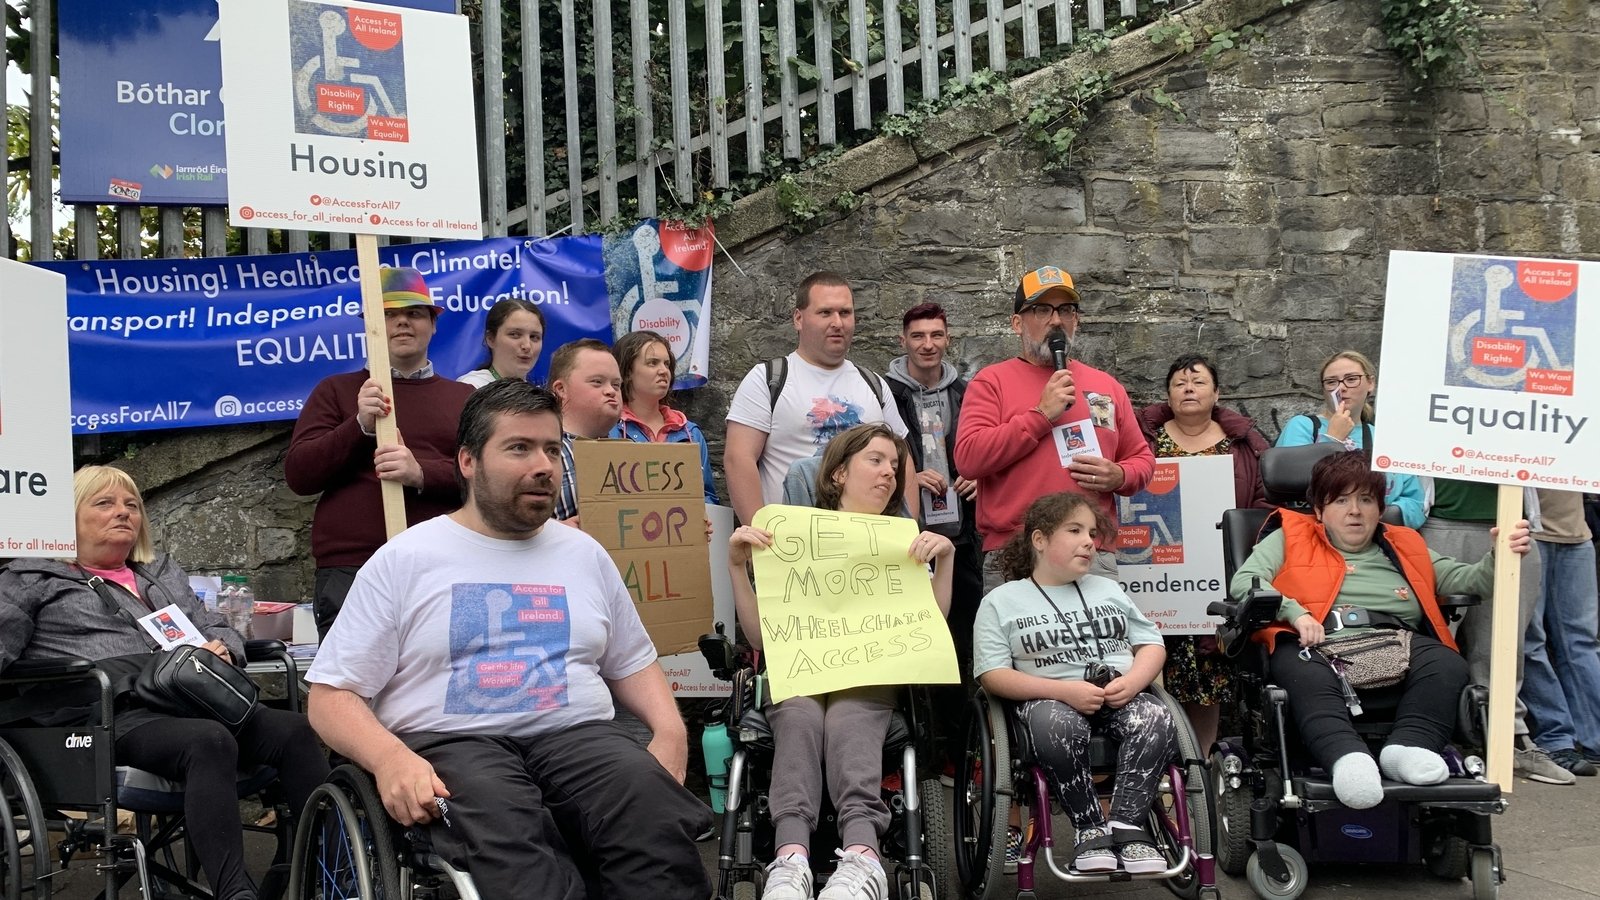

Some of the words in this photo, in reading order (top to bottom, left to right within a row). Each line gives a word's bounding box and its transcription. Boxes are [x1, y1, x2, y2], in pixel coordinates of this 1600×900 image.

[354, 15, 382, 26] Access
[384, 19, 397, 28] For
[355, 24, 368, 32] All
[369, 25, 397, 36] Ireland
[117, 80, 211, 106] Bóthar
[320, 87, 361, 101] Disability
[328, 101, 355, 112] Rights
[370, 119, 384, 128] We
[386, 119, 406, 129] Want
[373, 129, 404, 141] Equality
[290, 142, 429, 190] Housing
[322, 196, 401, 211] @AccessForAll7
[255, 210, 363, 225] access_for_all_ireland
[382, 217, 414, 228] Access
[416, 218, 430, 228] for
[432, 219, 444, 229] all
[446, 220, 478, 231] Ireland
[683, 231, 696, 242] All
[95, 264, 229, 299] Housing!
[411, 245, 521, 276] Climate!
[1523, 267, 1555, 277] Access
[1557, 269, 1573, 278] For
[1523, 277, 1537, 285] All
[1539, 277, 1573, 287] Ireland
[67, 307, 196, 338] ansport!
[207, 295, 362, 329] Independe
[639, 316, 681, 330] Disability
[236, 332, 368, 367] EQUALIT
[1476, 340, 1522, 354] Disability
[1483, 353, 1513, 365] Rights
[1529, 371, 1545, 380] We
[1547, 372, 1572, 382] Want
[1531, 382, 1568, 394] Equality
[71, 401, 192, 427] ccessForAll7
[1428, 393, 1589, 444] Equality
[1465, 450, 1556, 467] @AccessForAll7
[600, 461, 686, 494] ACCESS
[1153, 474, 1176, 482] Ireland
[1392, 461, 1509, 479] access_for_all_ireland
[1530, 472, 1569, 484] Access
[1572, 475, 1588, 486] for
[617, 506, 689, 548] FOR
[1117, 528, 1148, 539] Disability
[7, 537, 23, 550] for
[26, 538, 39, 550] all
[41, 539, 77, 551] Ireland
[765, 514, 890, 563] GET
[1123, 537, 1143, 546] Rights
[1156, 553, 1181, 563] Equality
[624, 560, 681, 602] ALL
[783, 563, 903, 603] MORE
[514, 585, 547, 594] Access
[549, 586, 563, 594] for
[521, 611, 563, 620] Ireland.
[1016, 614, 1050, 630] GIRLS
[1053, 610, 1078, 624] JUST
[762, 609, 932, 643] WHEELCHAIR
[1163, 622, 1188, 630] Access
[1189, 621, 1200, 629] for
[1201, 620, 1212, 629] all
[1020, 628, 1073, 654] HAVE
[1076, 615, 1127, 645] FUN
[787, 627, 933, 679] ACCESS
[679, 683, 699, 692] Access
[700, 682, 708, 692] for
[717, 683, 733, 692] Irelan
[65, 732, 93, 748] drive
